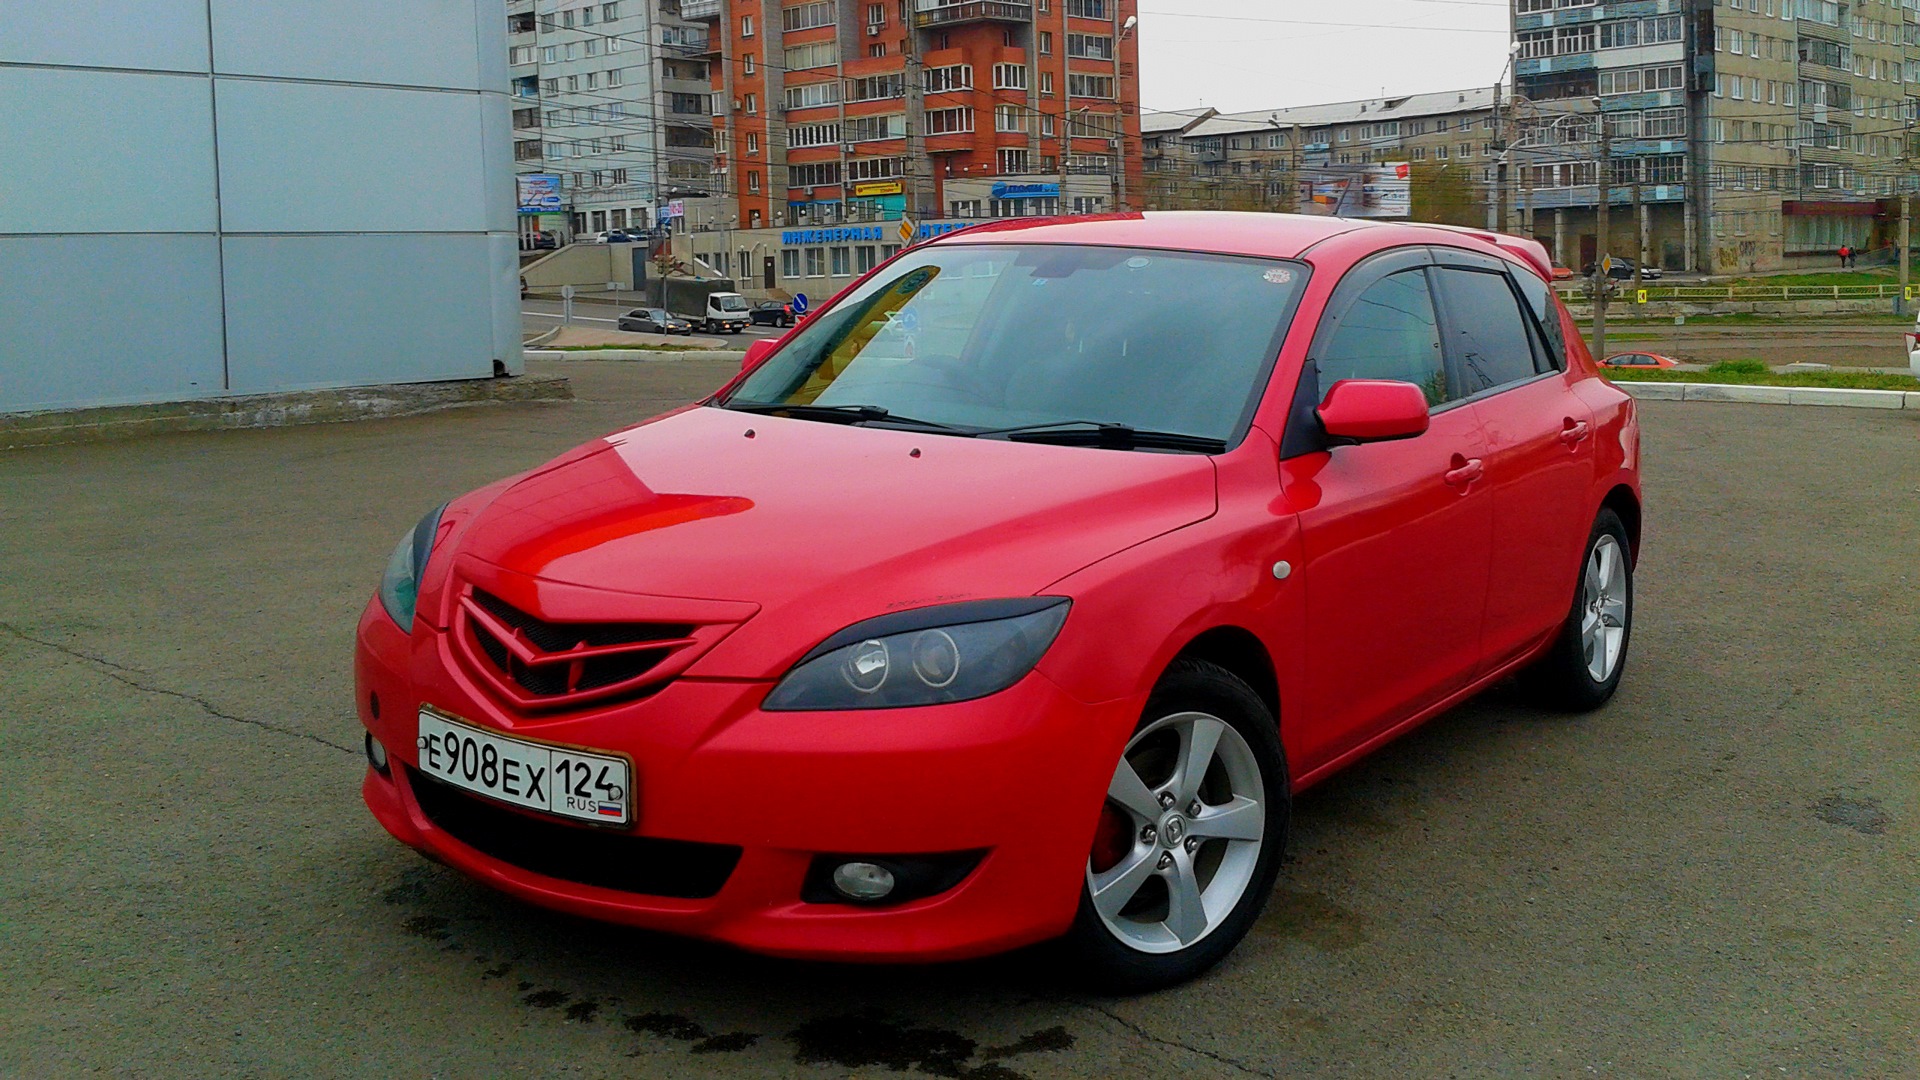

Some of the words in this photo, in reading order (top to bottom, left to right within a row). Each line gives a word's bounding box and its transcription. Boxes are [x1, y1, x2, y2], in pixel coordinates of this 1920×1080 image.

[782, 226, 882, 244] ИНЖЕНЕРНАЯ
[555, 759, 619, 800] 124
[566, 797, 597, 813] RUS
